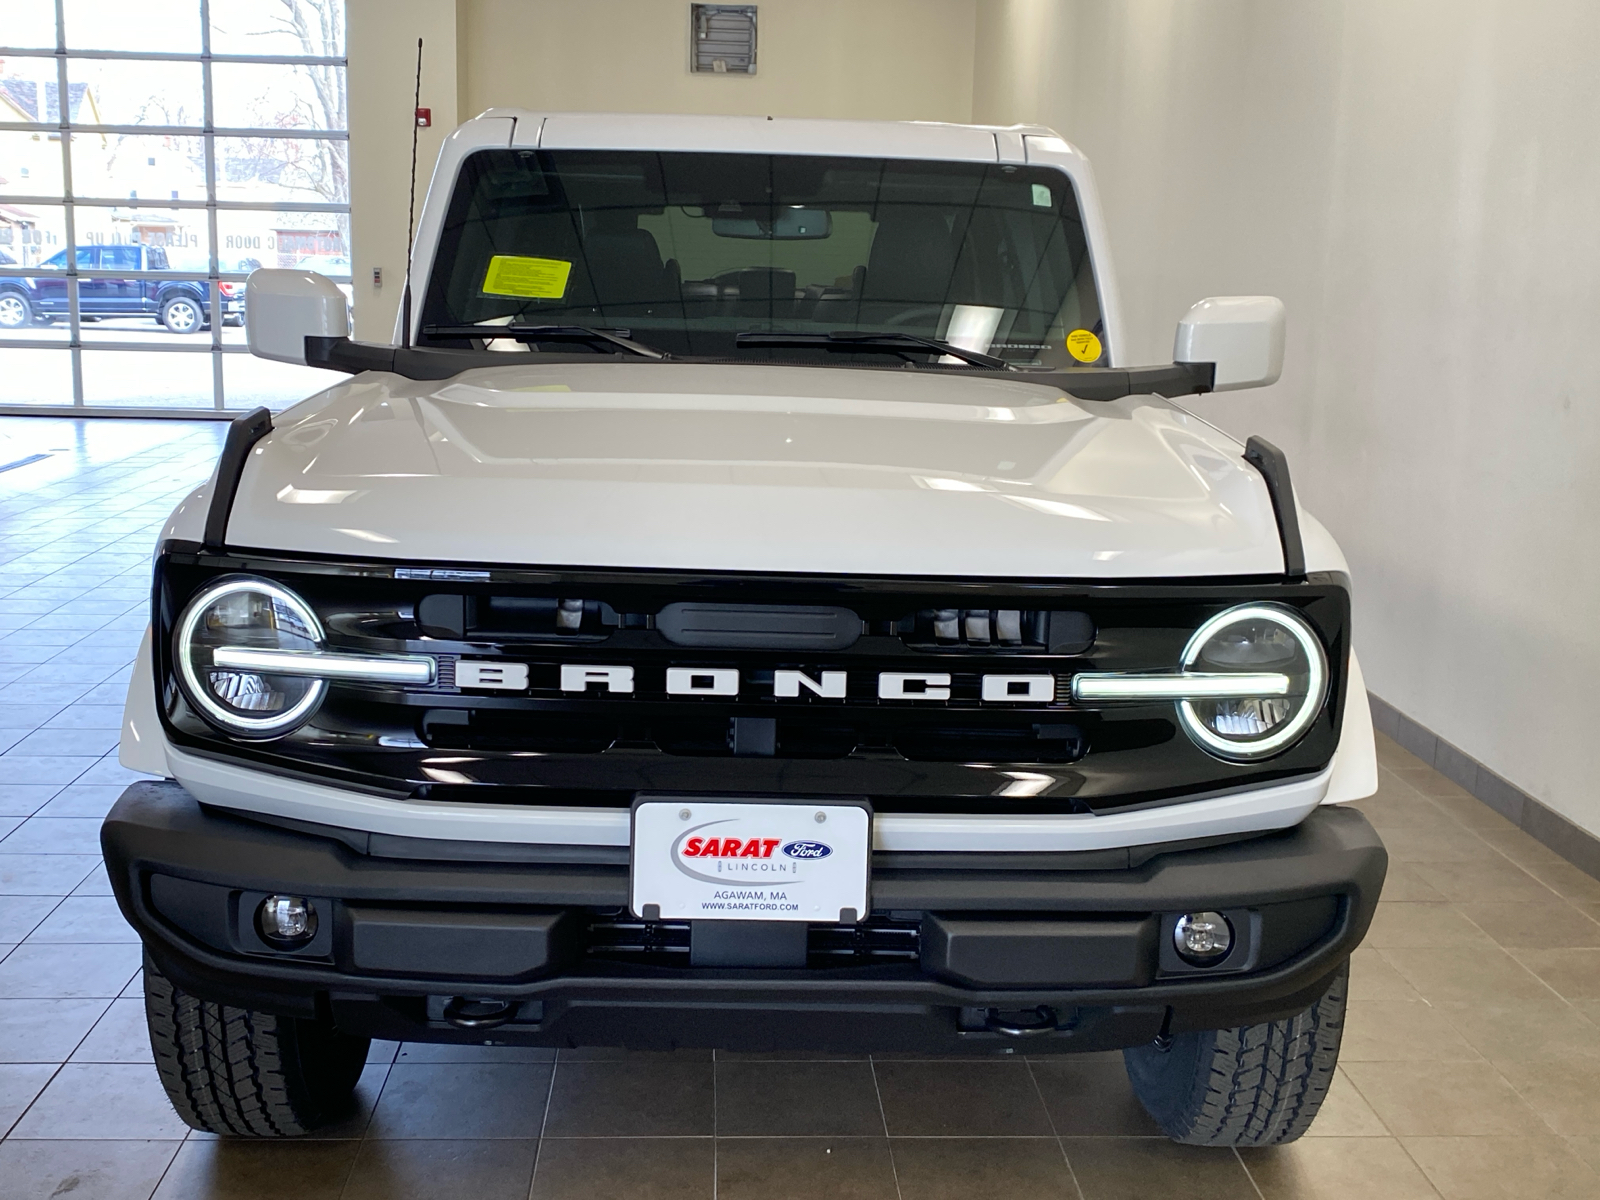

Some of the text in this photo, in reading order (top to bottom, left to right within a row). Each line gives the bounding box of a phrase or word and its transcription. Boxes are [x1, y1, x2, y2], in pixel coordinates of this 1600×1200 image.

[455, 660, 1055, 702] BRONCO
[682, 836, 825, 859] SARAT Ford
[727, 863, 787, 872] LINCOLN
[713, 890, 788, 901] AGAWAM, MA
[701, 902, 799, 911] WWW.SARATFORD.COM
